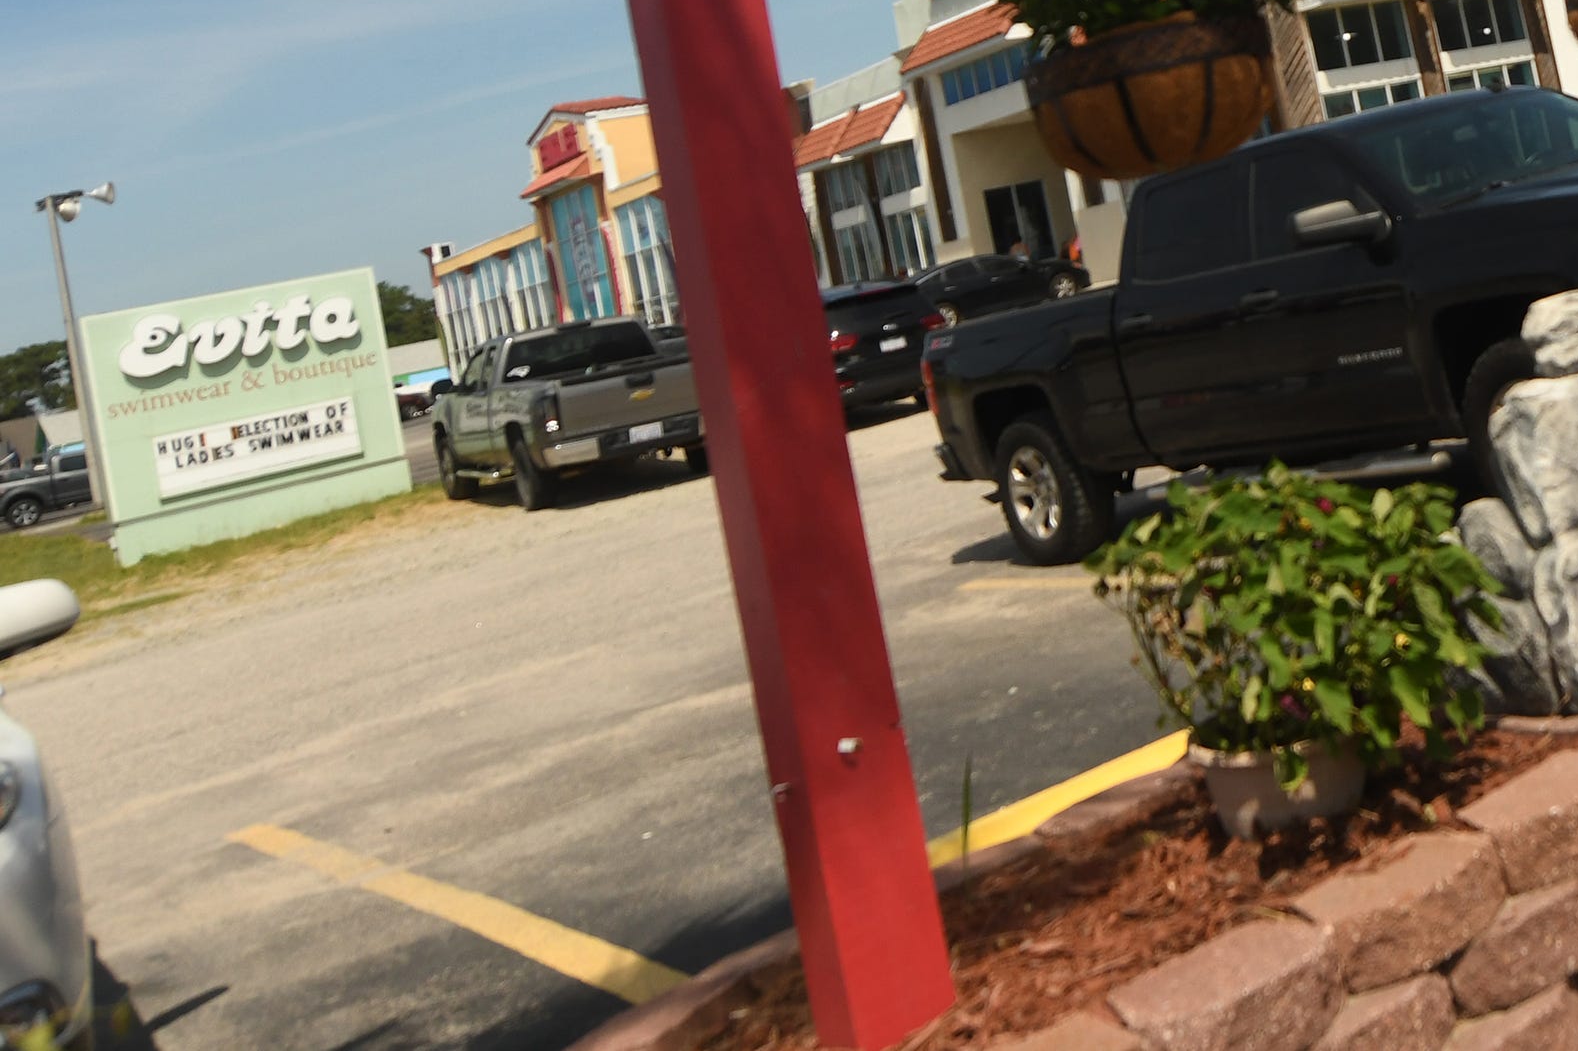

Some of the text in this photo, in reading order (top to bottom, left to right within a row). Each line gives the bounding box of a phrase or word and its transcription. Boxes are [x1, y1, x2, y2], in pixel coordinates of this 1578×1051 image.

[119, 293, 360, 378] Evita
[108, 351, 377, 419] swimwear & boutique
[157, 402, 349, 455] HUG ELECTION OF
[248, 421, 345, 454] SWIMWEAR
